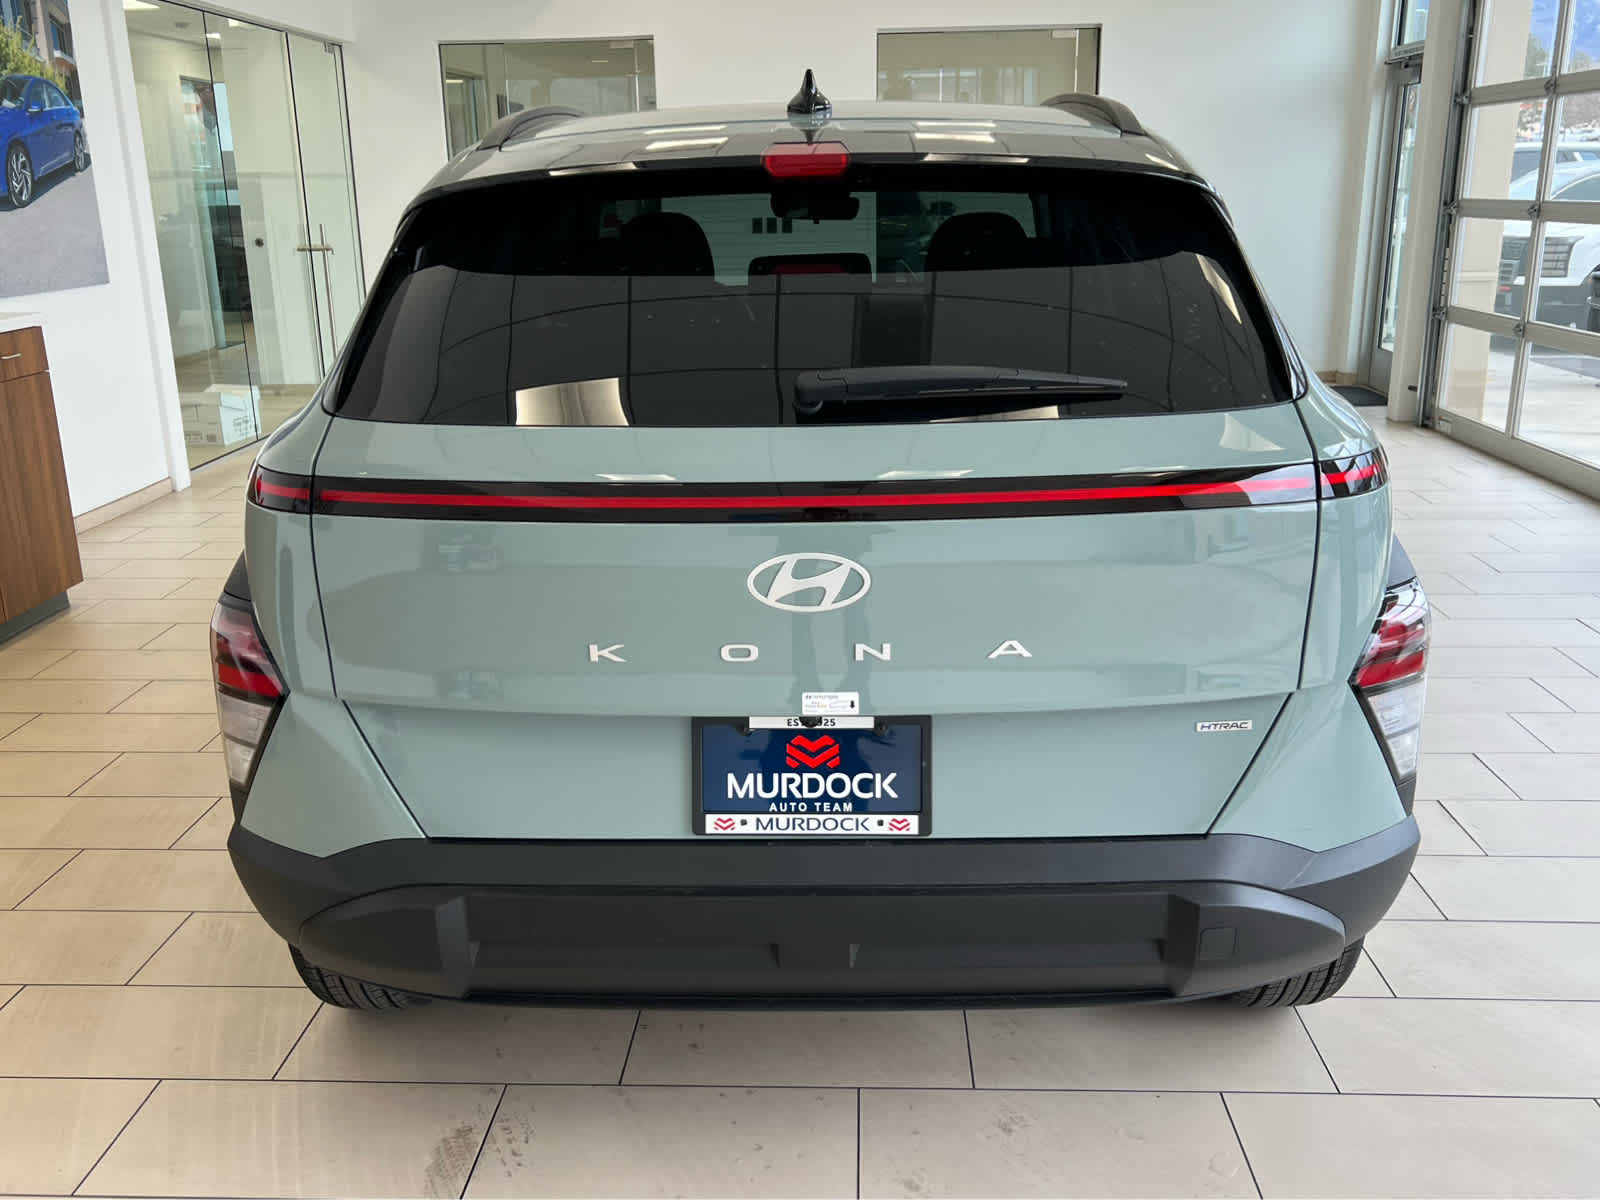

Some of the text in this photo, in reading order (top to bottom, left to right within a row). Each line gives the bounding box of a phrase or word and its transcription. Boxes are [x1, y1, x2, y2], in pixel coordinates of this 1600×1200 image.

[588, 640, 1033, 663] KONA
[786, 718, 803, 728] ES
[1199, 721, 1249, 731] HTRAC
[727, 772, 899, 799] MURDOCK
[769, 802, 853, 813] AUTO TEAM
[755, 817, 871, 832] MURDOCK
